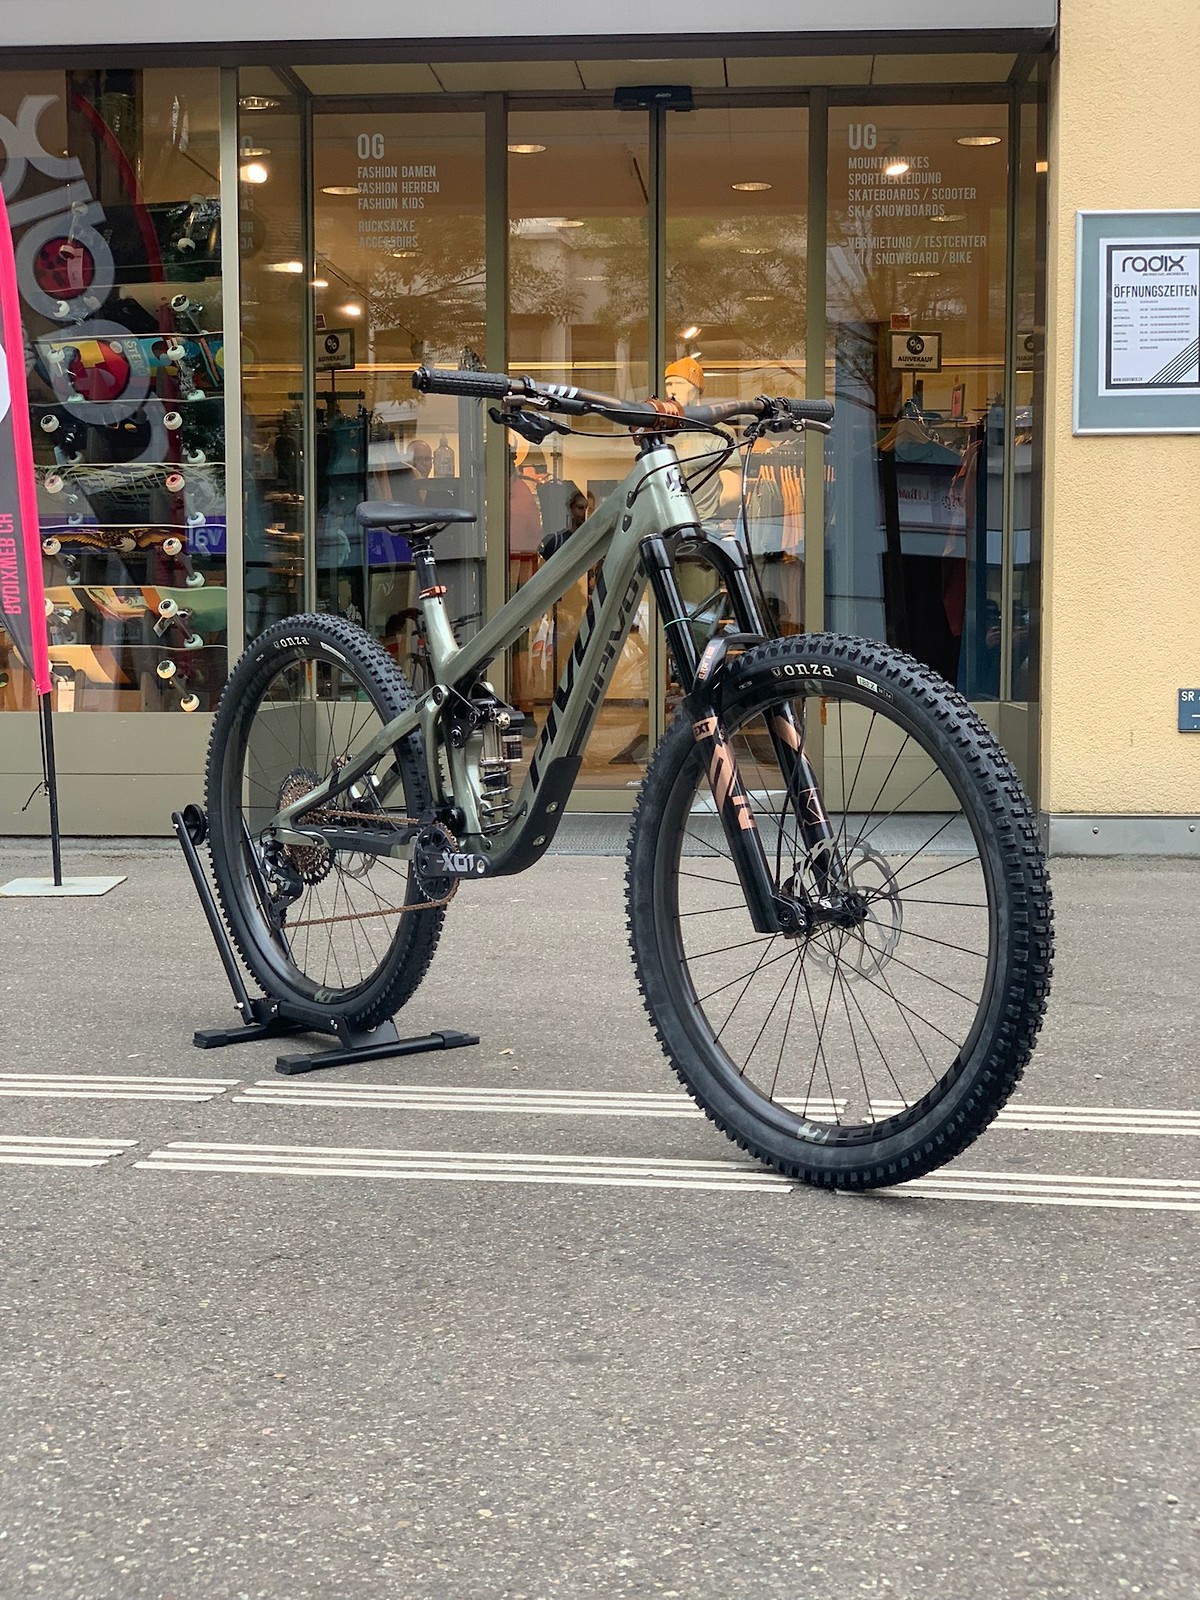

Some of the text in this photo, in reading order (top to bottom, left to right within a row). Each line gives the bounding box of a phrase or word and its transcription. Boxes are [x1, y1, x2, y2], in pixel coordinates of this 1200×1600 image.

[848, 123, 877, 150] UG
[357, 133, 385, 160] OG
[357, 165, 437, 179] FASHION DAMEN
[357, 181, 440, 194] FASHION HERREN
[848, 188, 920, 201] SKATEBOARDS
[931, 187, 977, 200] SCOOTER
[357, 197, 425, 210] FASHION KIDS
[848, 205, 865, 217] SKI
[874, 204, 945, 217] SNOWBOARDS
[848, 236, 912, 249] VERMIETUNG
[923, 235, 987, 248] TESTCENTER
[875, 252, 939, 265] SNOWBOARD
[949, 251, 973, 264] BIKE
[1121, 254, 1185, 273] radix
[1113, 283, 1198, 298] ÖFFNUNGSZEITEN
[280, 635, 310, 648] onza
[783, 663, 835, 678] onza
[1181, 691, 1195, 702] SR
